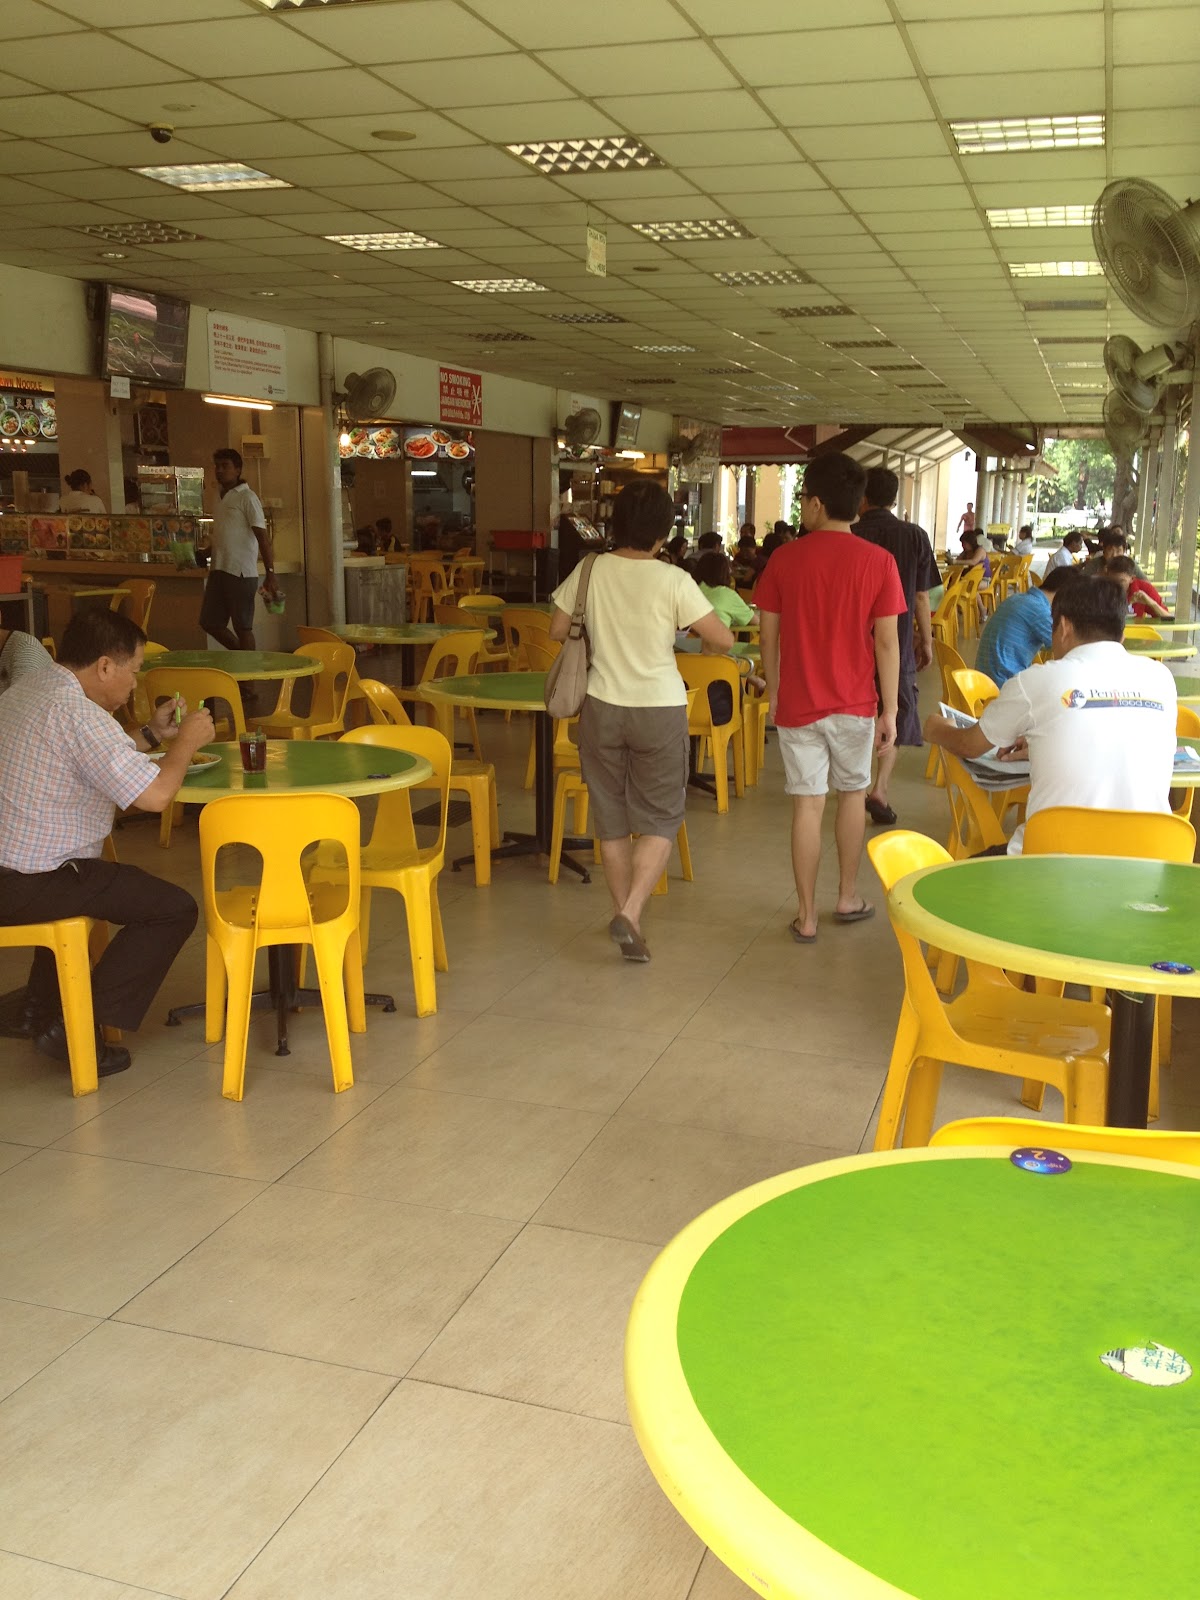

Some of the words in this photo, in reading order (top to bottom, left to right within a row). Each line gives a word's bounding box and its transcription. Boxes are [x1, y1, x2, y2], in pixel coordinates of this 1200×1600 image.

[16, 377, 43, 391] NOODLE
[440, 372, 448, 383] NO
[449, 373, 471, 388] SMOKING
[1090, 689, 1141, 704] Penjuru
[1118, 699, 1143, 707] food
